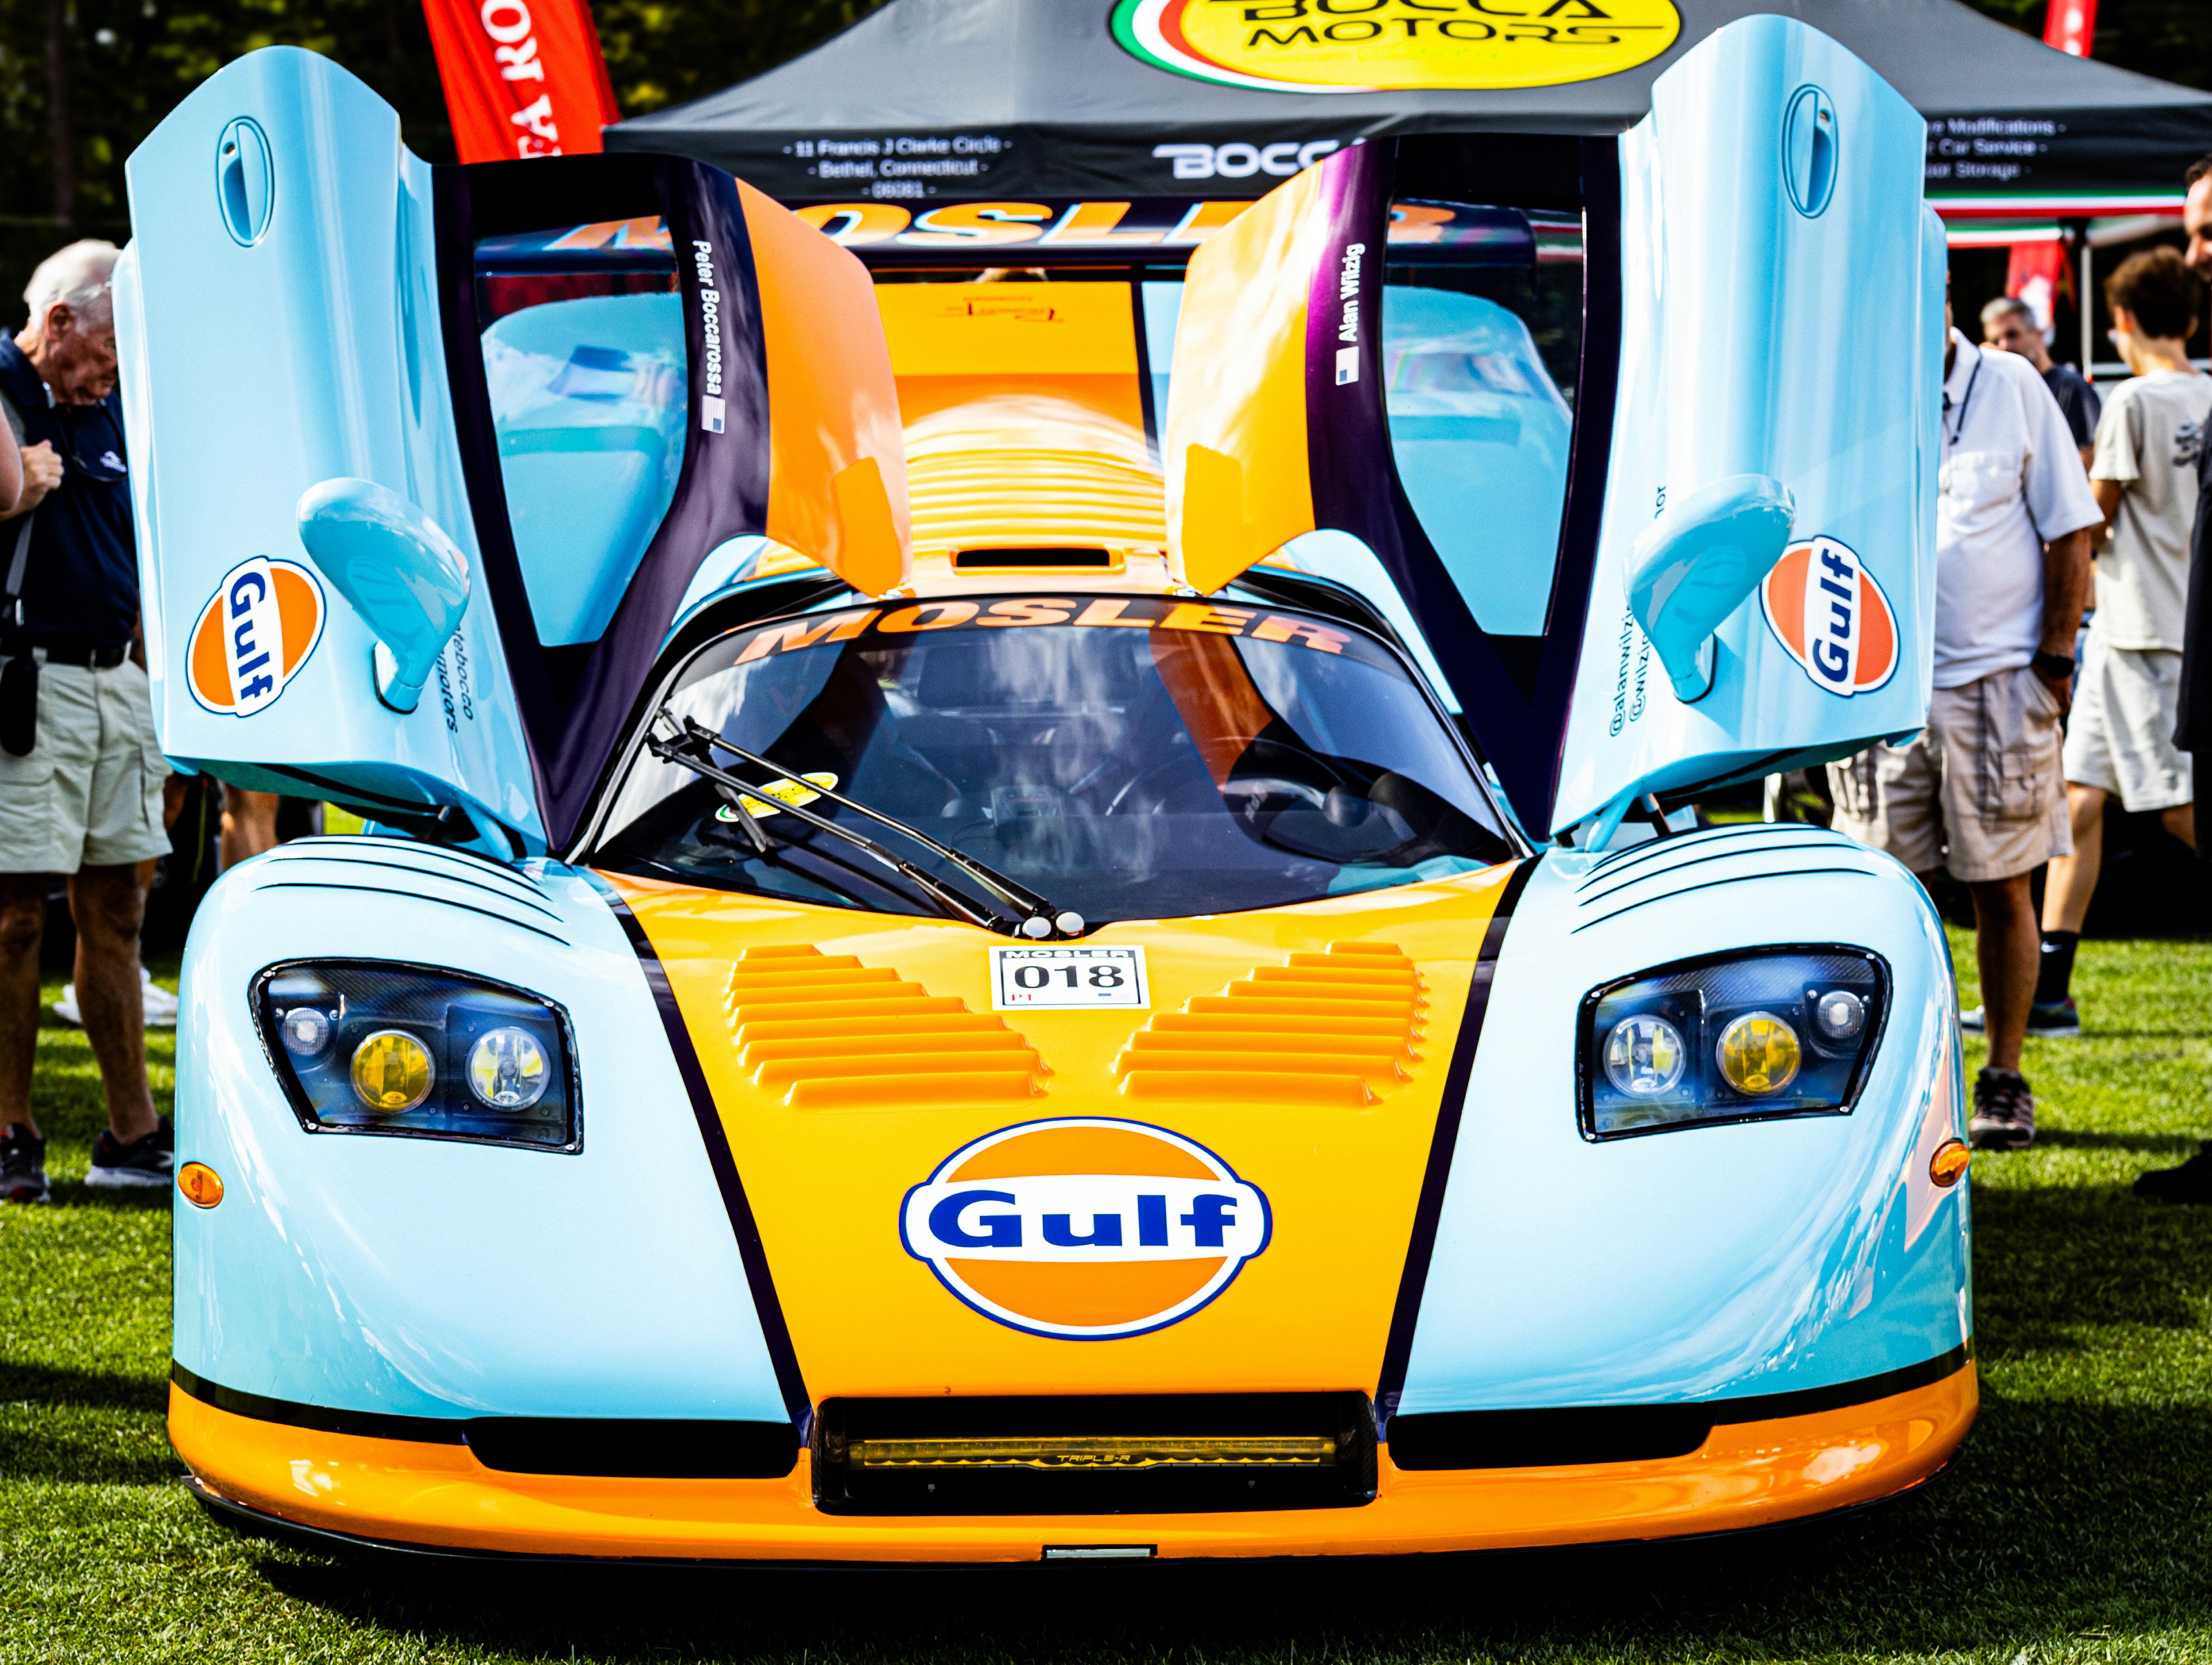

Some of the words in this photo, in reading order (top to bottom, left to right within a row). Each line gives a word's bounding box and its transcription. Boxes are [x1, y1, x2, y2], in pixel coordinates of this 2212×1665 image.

[1249, 18, 1664, 46] MOTORS
[795, 141, 813, 156] 11
[818, 139, 880, 156] Francis
[883, 138, 894, 155] J
[896, 137, 950, 155] Clarke
[952, 136, 1002, 153] Circle
[1938, 138, 1969, 156] Car
[1973, 138, 2037, 157] Service
[1948, 117, 2056, 136] Modifications
[880, 158, 978, 176] Connecticut
[1152, 137, 1366, 179] BOCC
[1955, 160, 2021, 181] Storage
[692, 240, 714, 286] Peter
[1340, 243, 1366, 300] Wilzig
[701, 289, 722, 395] Boccarossa
[1339, 300, 1358, 342] Alan
[230, 572, 273, 701] Gulf
[733, 598, 1353, 665] MOSLER
[1812, 548, 1853, 682] Gulf
[436, 649, 458, 733] motors
[454, 625, 473, 719] tebocco
[1610, 607, 1634, 736] @alanwilzi
[1006, 950, 1129, 959] MOSLER
[1015, 965, 1124, 989] 018
[929, 1190, 1238, 1248] Gulf
